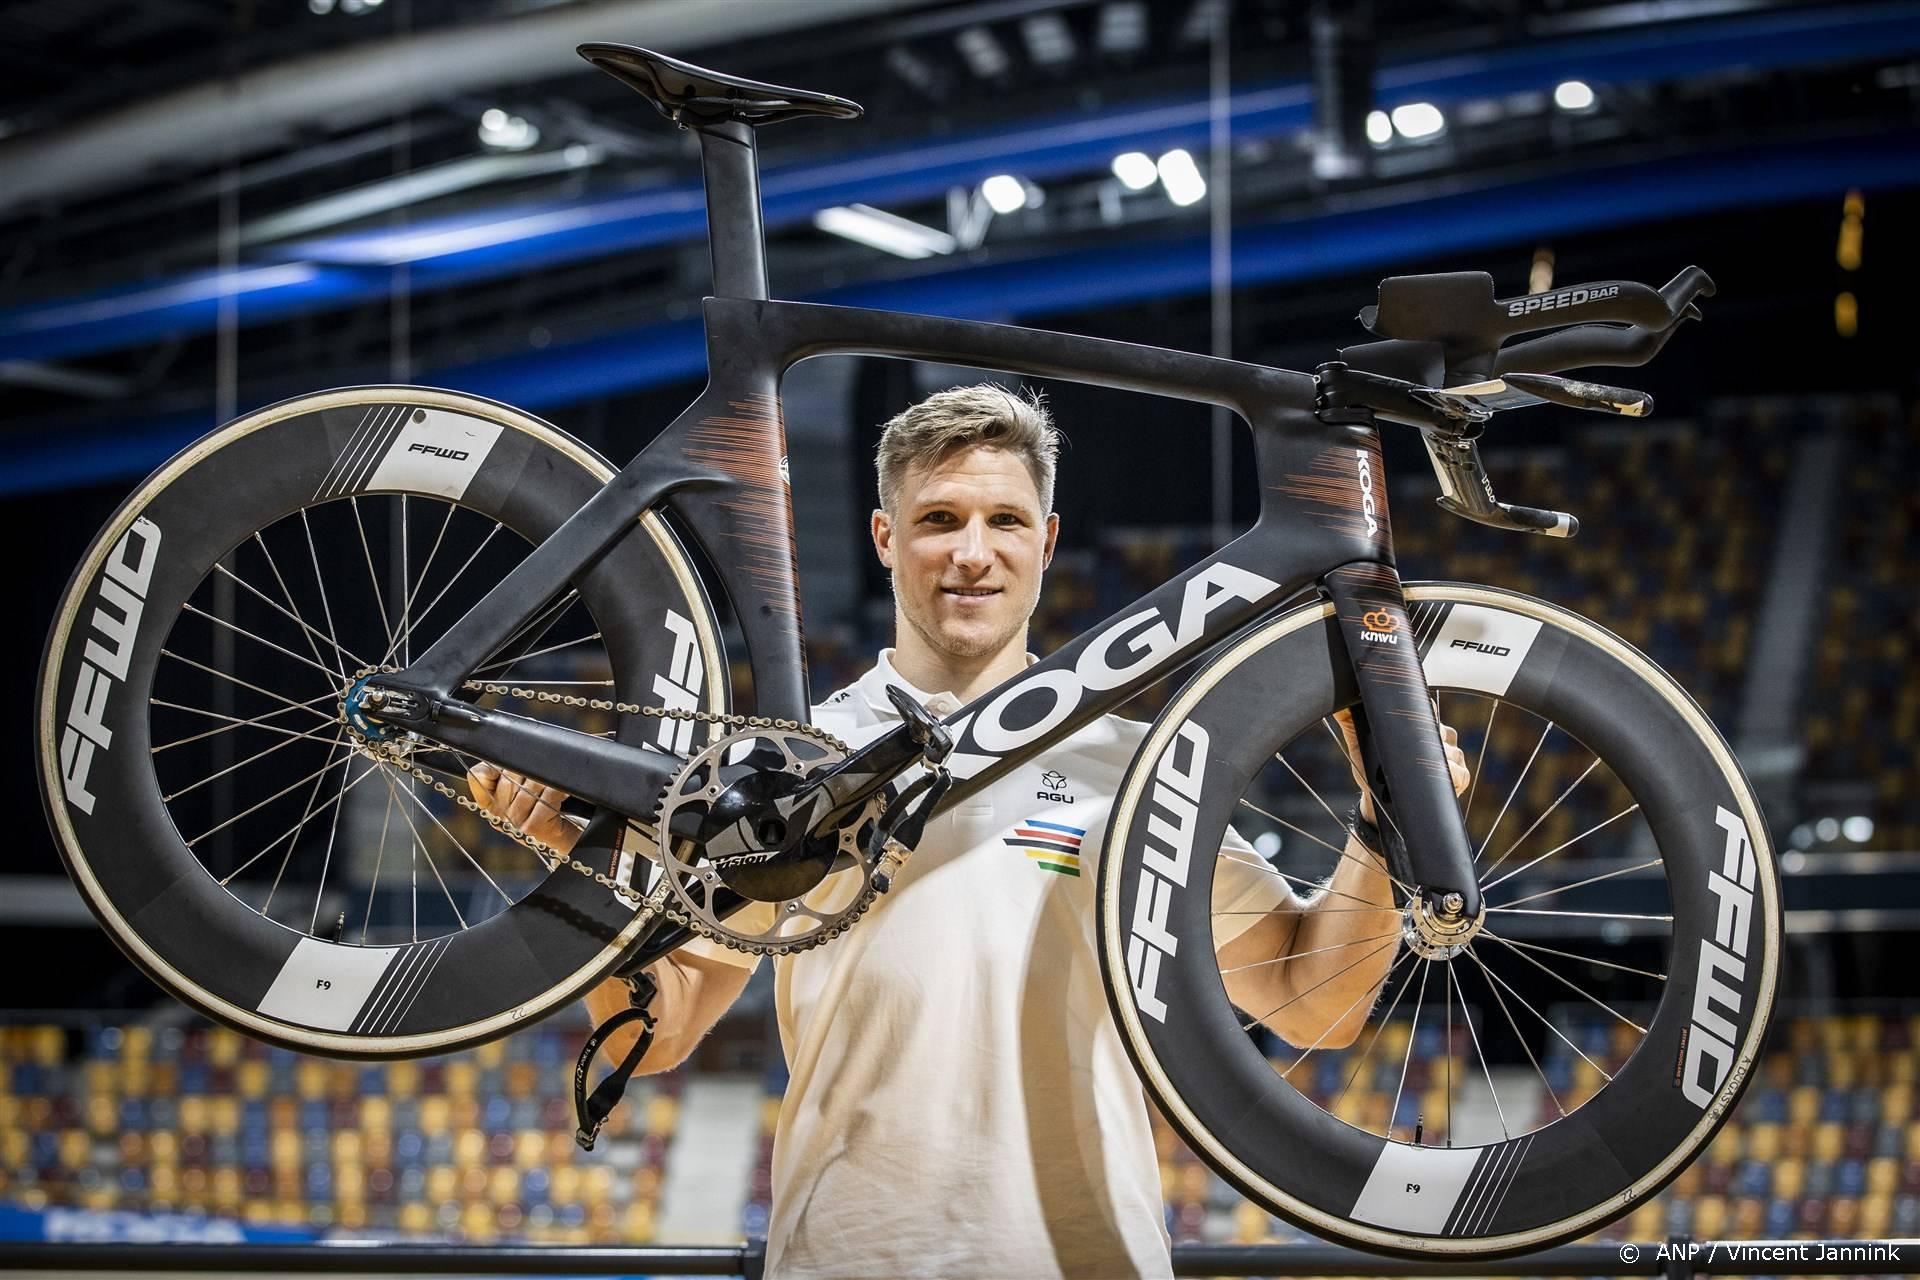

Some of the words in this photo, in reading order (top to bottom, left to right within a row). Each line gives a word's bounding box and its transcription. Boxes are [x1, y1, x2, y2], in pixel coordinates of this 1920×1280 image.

[408, 443, 469, 461] FFWD
[1356, 449, 1378, 538] KOGA
[1450, 638, 1511, 657] FFWD
[60, 515, 162, 816] FFWD
[1036, 791, 1074, 804] AGU
[1127, 718, 1210, 1024] FFWD
[1681, 805, 1757, 1110] FFWD
[316, 979, 332, 991] F9
[1405, 1183, 1421, 1195] F9
